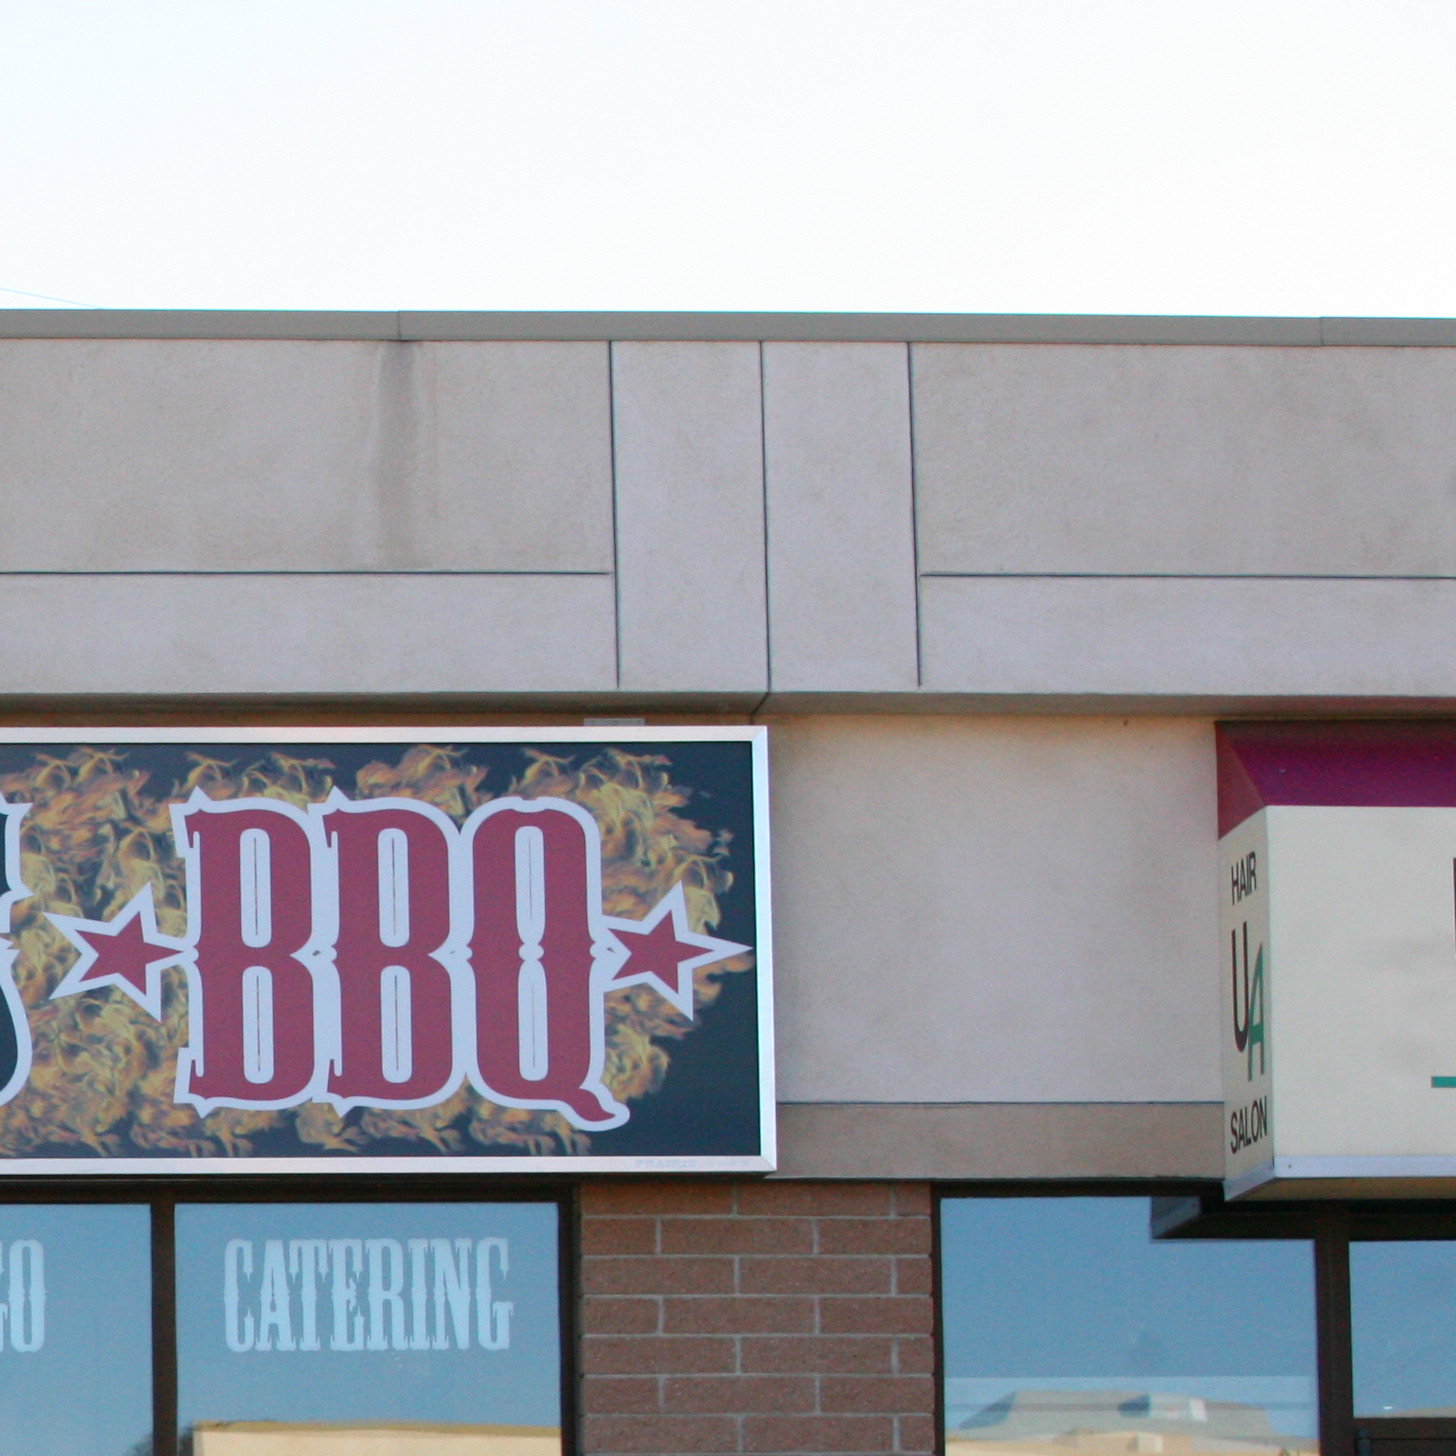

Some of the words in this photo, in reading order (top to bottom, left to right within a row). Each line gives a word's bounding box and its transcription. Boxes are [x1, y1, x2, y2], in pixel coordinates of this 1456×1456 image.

[1231, 851, 1257, 906] HAIR
[173, 785, 629, 1130] BBQ
[1230, 1096, 1267, 1154] SALON
[224, 1237, 514, 1353] CATERING
